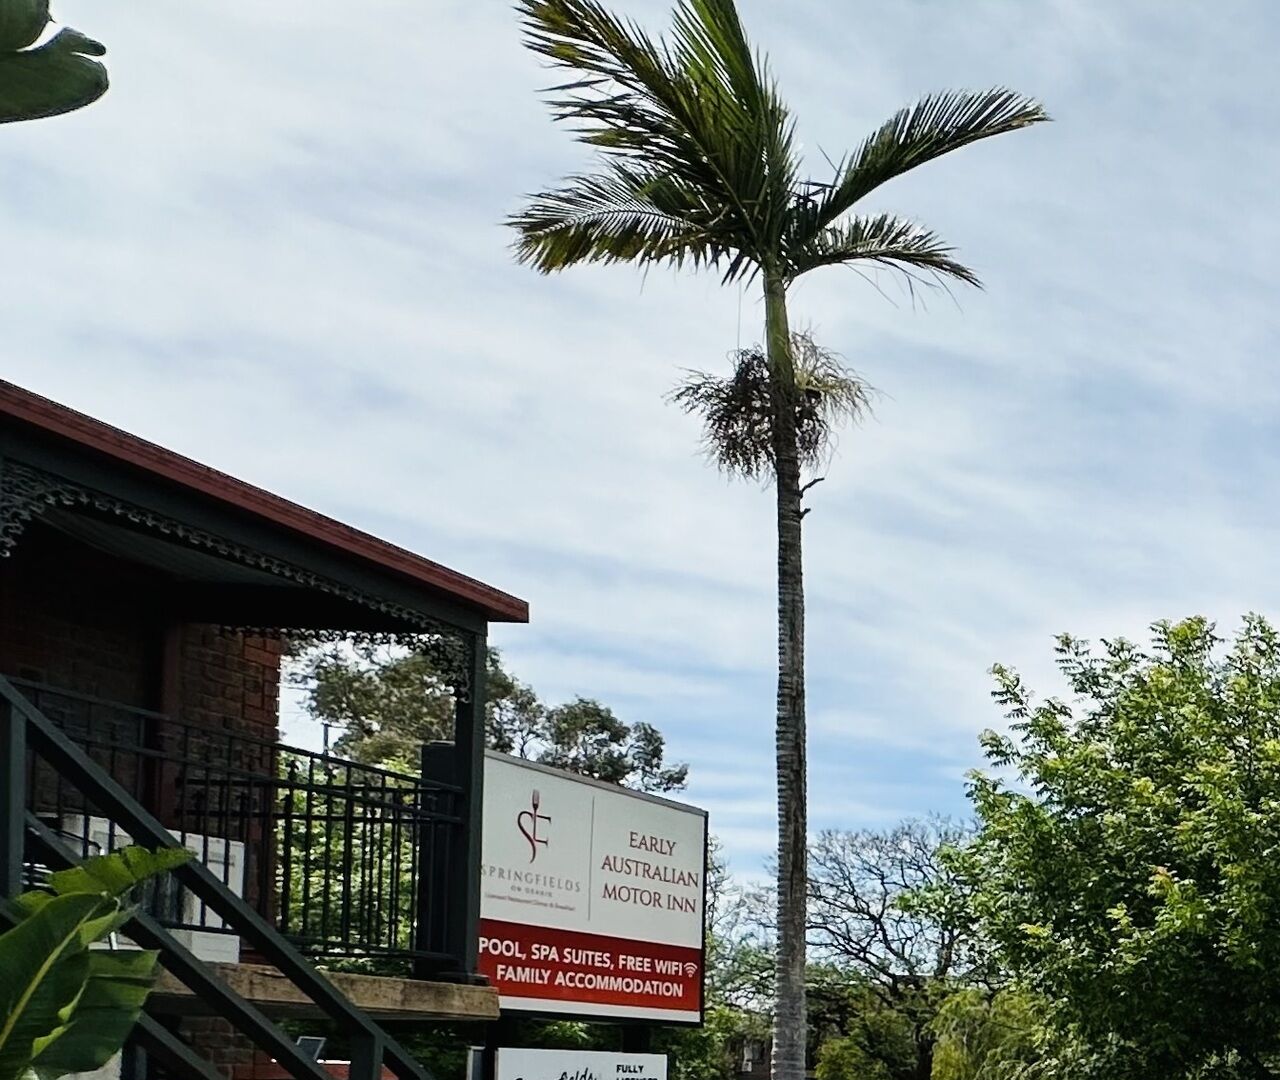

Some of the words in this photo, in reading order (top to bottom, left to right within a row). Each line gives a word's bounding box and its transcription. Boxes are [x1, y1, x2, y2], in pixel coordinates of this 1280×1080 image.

[629, 831, 677, 856] EARLY
[481, 864, 581, 893] SPRINGFIELDS
[601, 855, 699, 888] AUSTRALIAN
[602, 882, 663, 909] MOTOR
[667, 894, 697, 913] INN
[478, 936, 527, 961] POOL,
[531, 943, 560, 962] SPA
[563, 947, 614, 971] SUITES,
[618, 954, 652, 973] FREE
[654, 959, 683, 976] WIFI
[496, 964, 551, 985] FAMILY
[554, 970, 683, 998] ACCOMMODATION
[616, 1064, 645, 1073] FULLY
